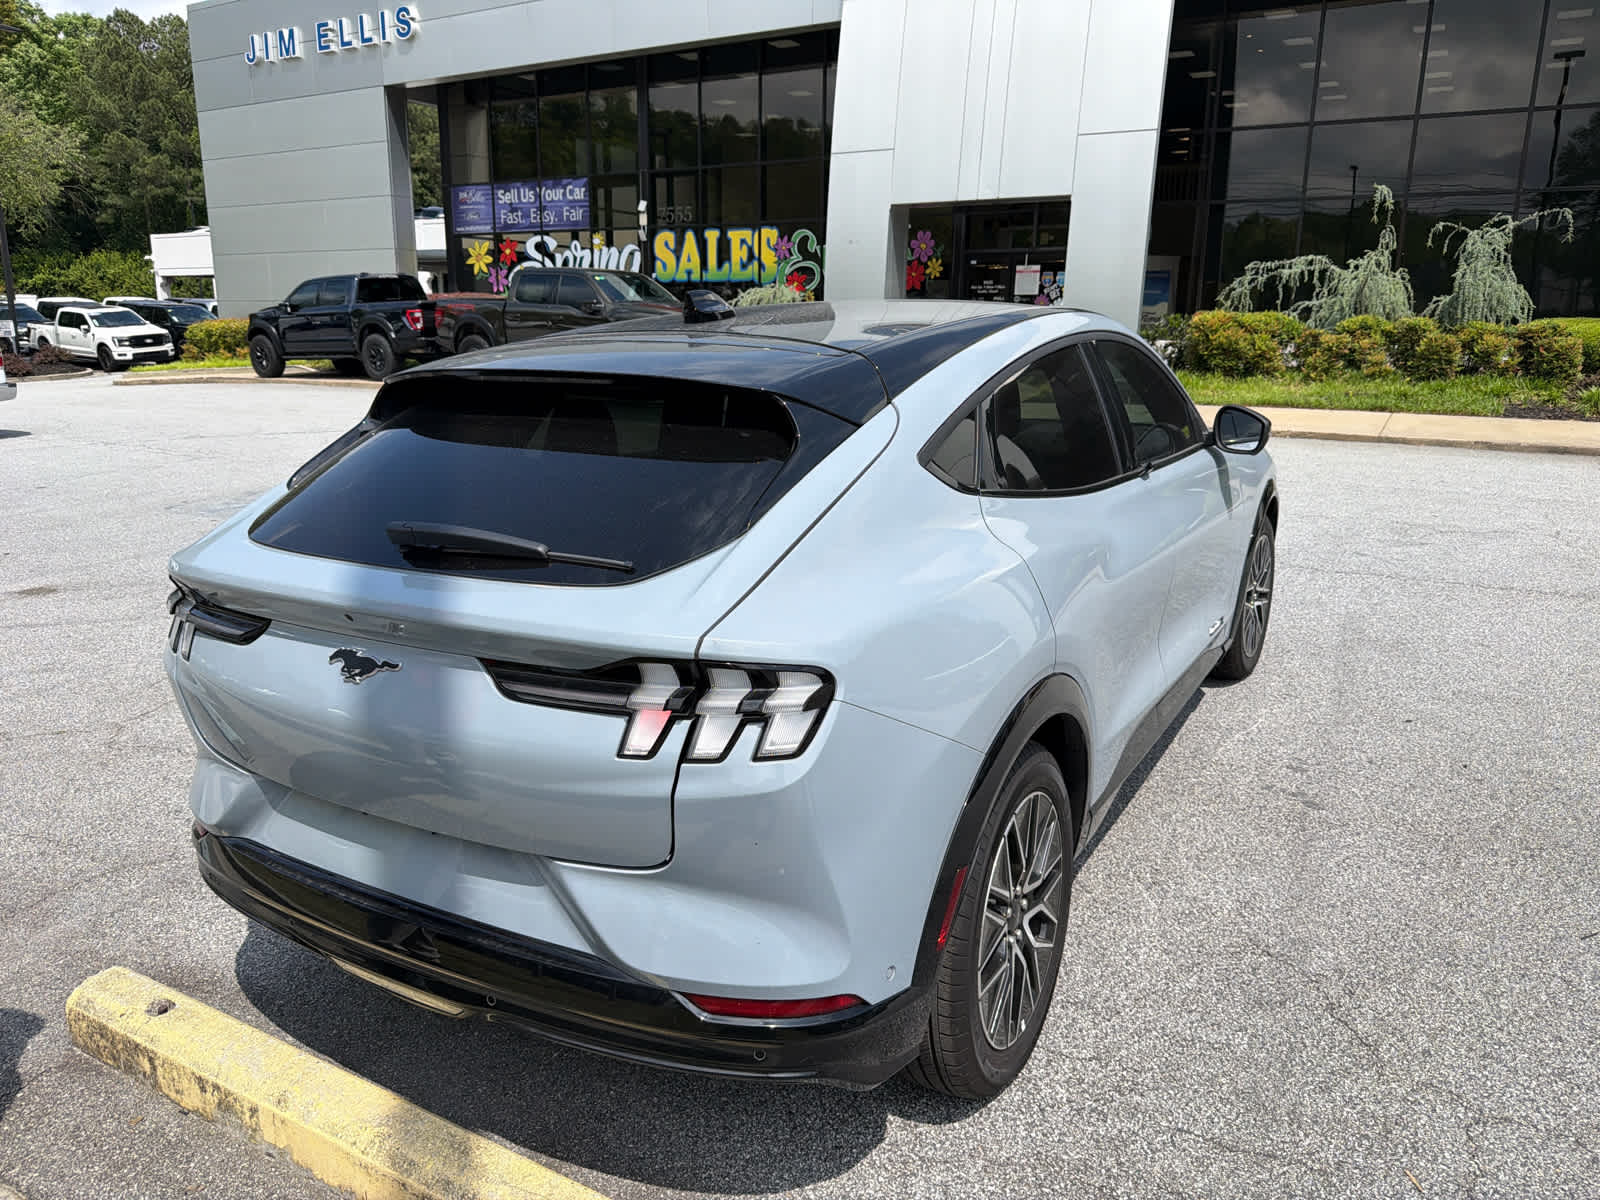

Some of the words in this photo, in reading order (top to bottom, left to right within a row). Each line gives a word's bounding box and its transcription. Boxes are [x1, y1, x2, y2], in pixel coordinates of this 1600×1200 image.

[244, 27, 302, 65] JIM
[315, 6, 417, 53] ELLIS
[497, 188, 519, 204] Sell
[520, 187, 536, 203] Us
[536, 186, 564, 202] Your
[566, 184, 586, 200] Car
[500, 209, 526, 225] Fast.
[563, 206, 584, 222] Fair
[653, 225, 779, 286] SALES
